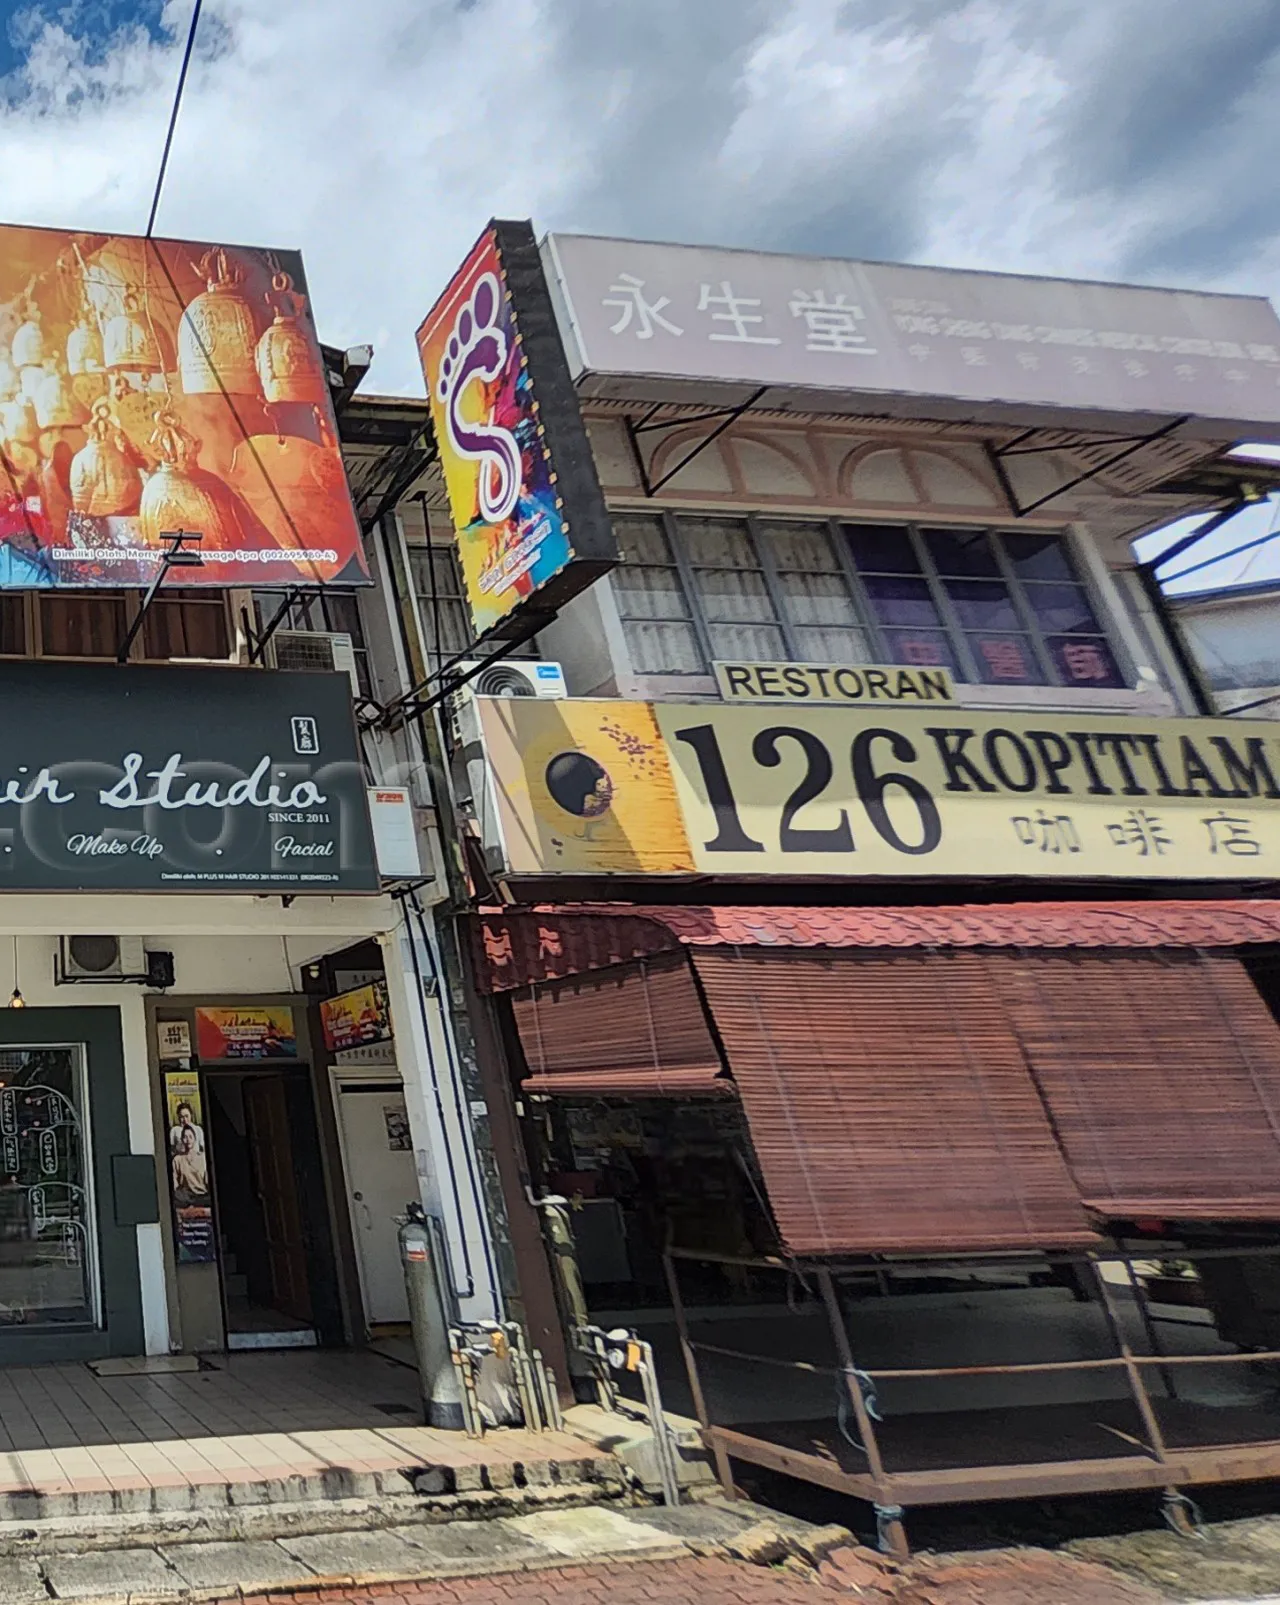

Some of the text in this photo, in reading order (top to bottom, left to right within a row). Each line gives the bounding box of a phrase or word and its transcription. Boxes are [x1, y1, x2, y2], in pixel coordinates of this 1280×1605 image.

[602, 271, 878, 356] 永生堂
[236, 551, 258, 564] Spa
[731, 667, 952, 701] RESTORAN
[99, 753, 328, 810] Studio
[673, 723, 1280, 856] 126 KOPITIAM
[268, 812, 331, 824] SINCE 2011
[1011, 808, 1263, 857] 咖啡店
[67, 833, 129, 856] Make
[129, 834, 165, 859] Up
[273, 836, 335, 859] Facial
